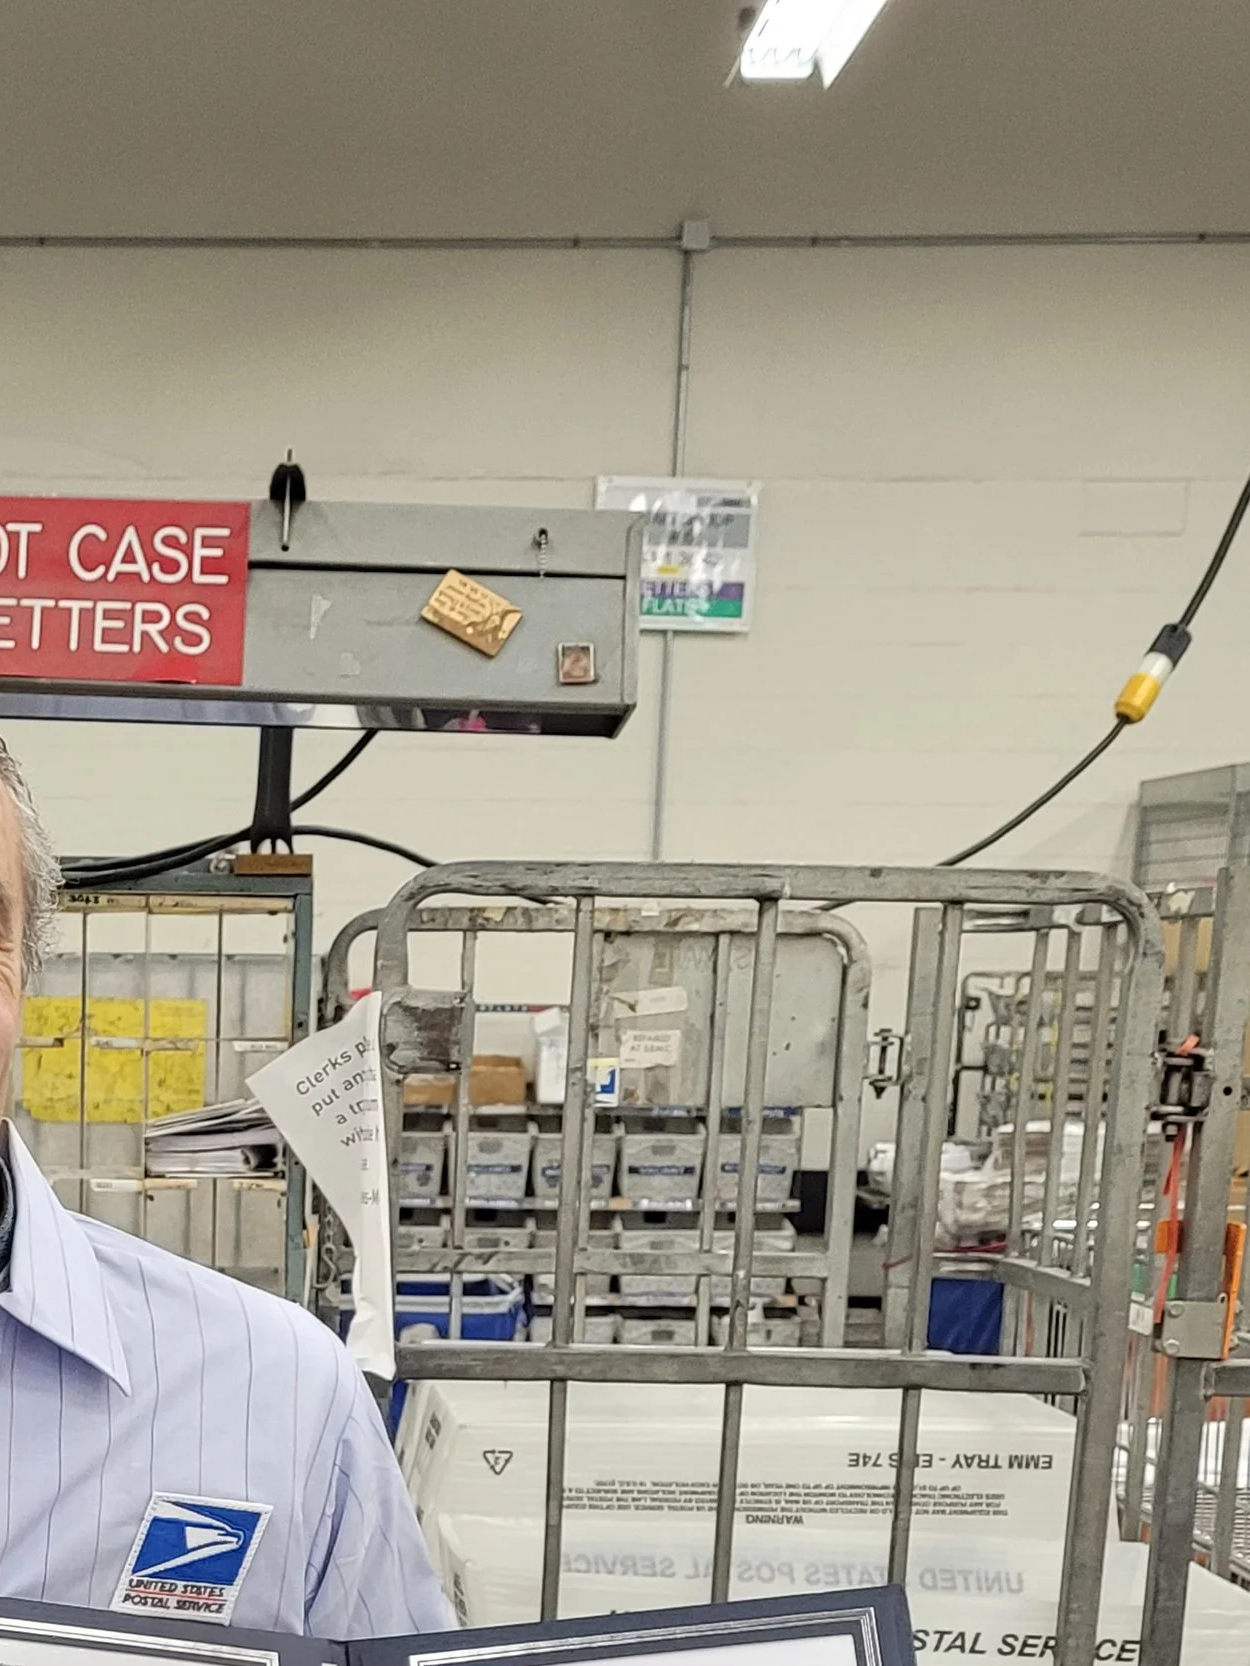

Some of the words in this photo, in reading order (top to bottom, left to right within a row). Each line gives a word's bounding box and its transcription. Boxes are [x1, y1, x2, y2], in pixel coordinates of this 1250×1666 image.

[69, 524, 231, 584] CASE
[296, 1050, 351, 1095] Clerks
[312, 1089, 340, 1116] put
[335, 1113, 347, 1124] a
[848, 1452, 882, 1468] 74E
[888, 1452, 933, 1469] ES
[951, 1453, 1002, 1469] TRAY
[1008, 1453, 1053, 1469] EMM
[746, 1513, 804, 1525] WARNING
[128, 1578, 178, 1593] UNITED
[181, 1584, 225, 1598] STATES
[122, 1593, 170, 1609] POSTAL
[174, 1600, 226, 1614] SERVICE
[997, 1634, 1141, 1662] SERCE
